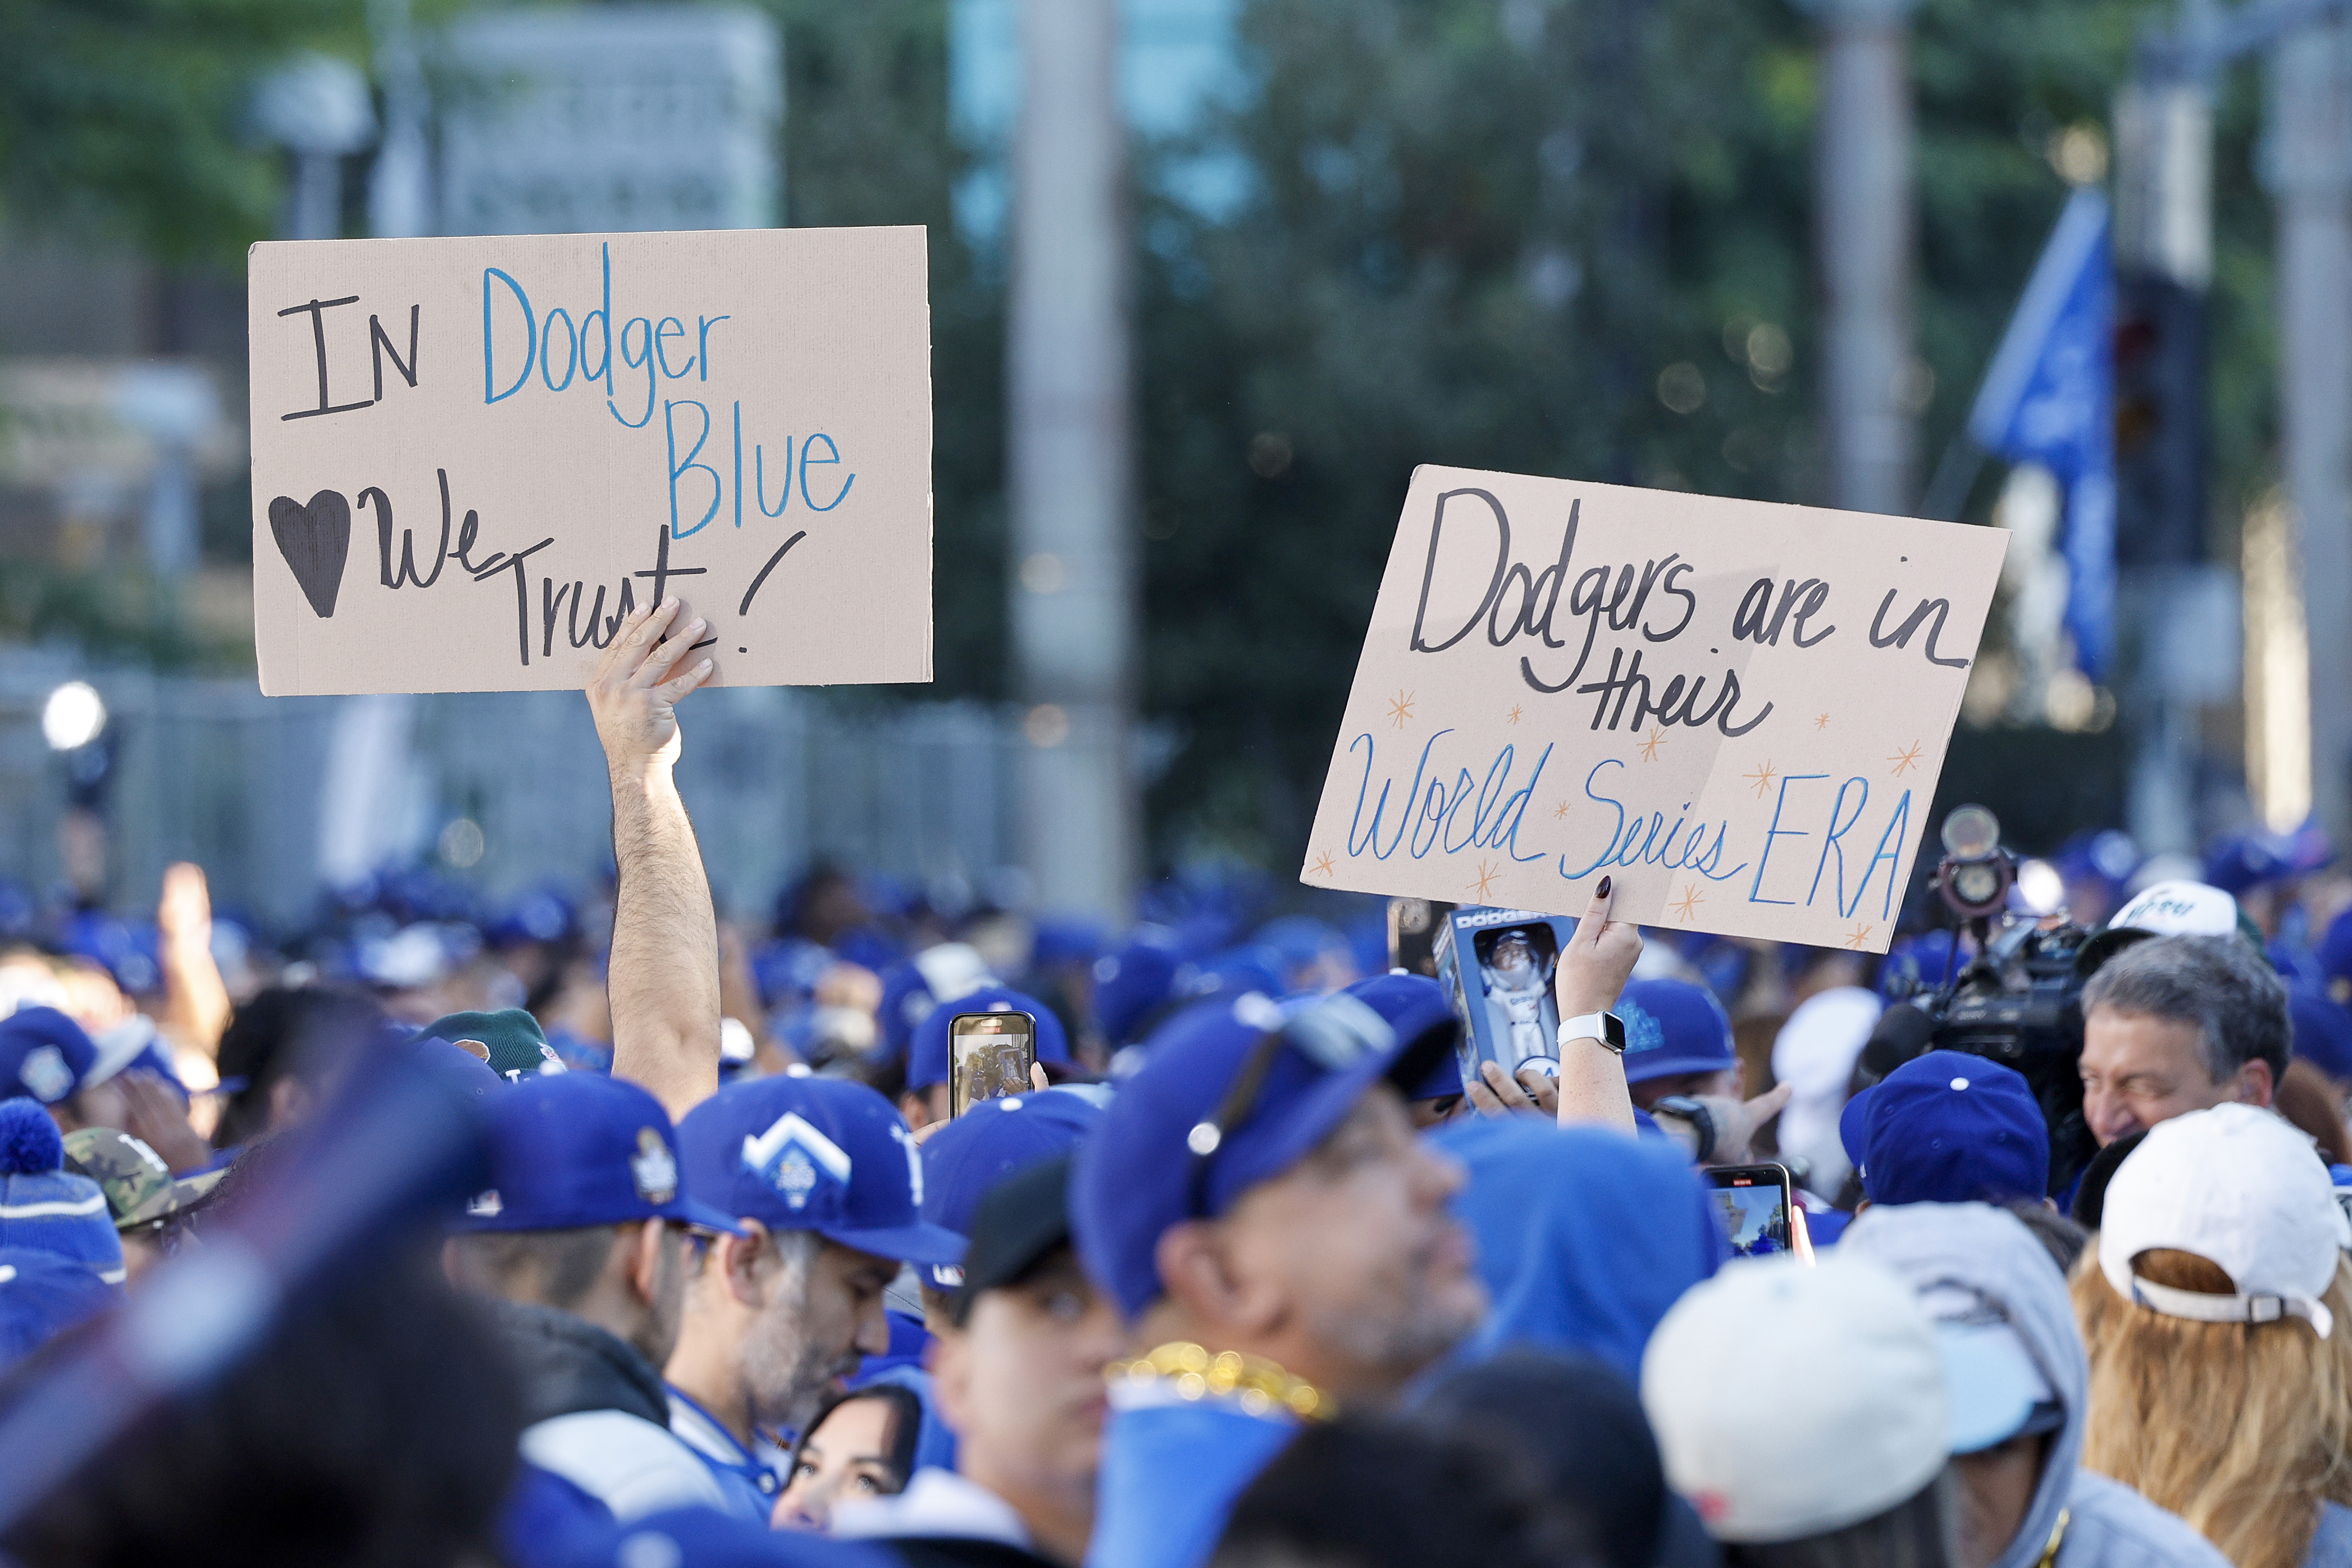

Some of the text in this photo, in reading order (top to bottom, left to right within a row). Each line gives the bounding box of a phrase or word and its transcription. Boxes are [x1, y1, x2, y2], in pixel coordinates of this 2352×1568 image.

[277, 242, 731, 429] IN Dodger
[357, 468, 506, 590] We
[665, 399, 856, 540] Blue
[1409, 487, 1970, 694] Dodgers are in
[1576, 647, 1774, 737] their
[1347, 729, 1912, 922] World Series ERA
